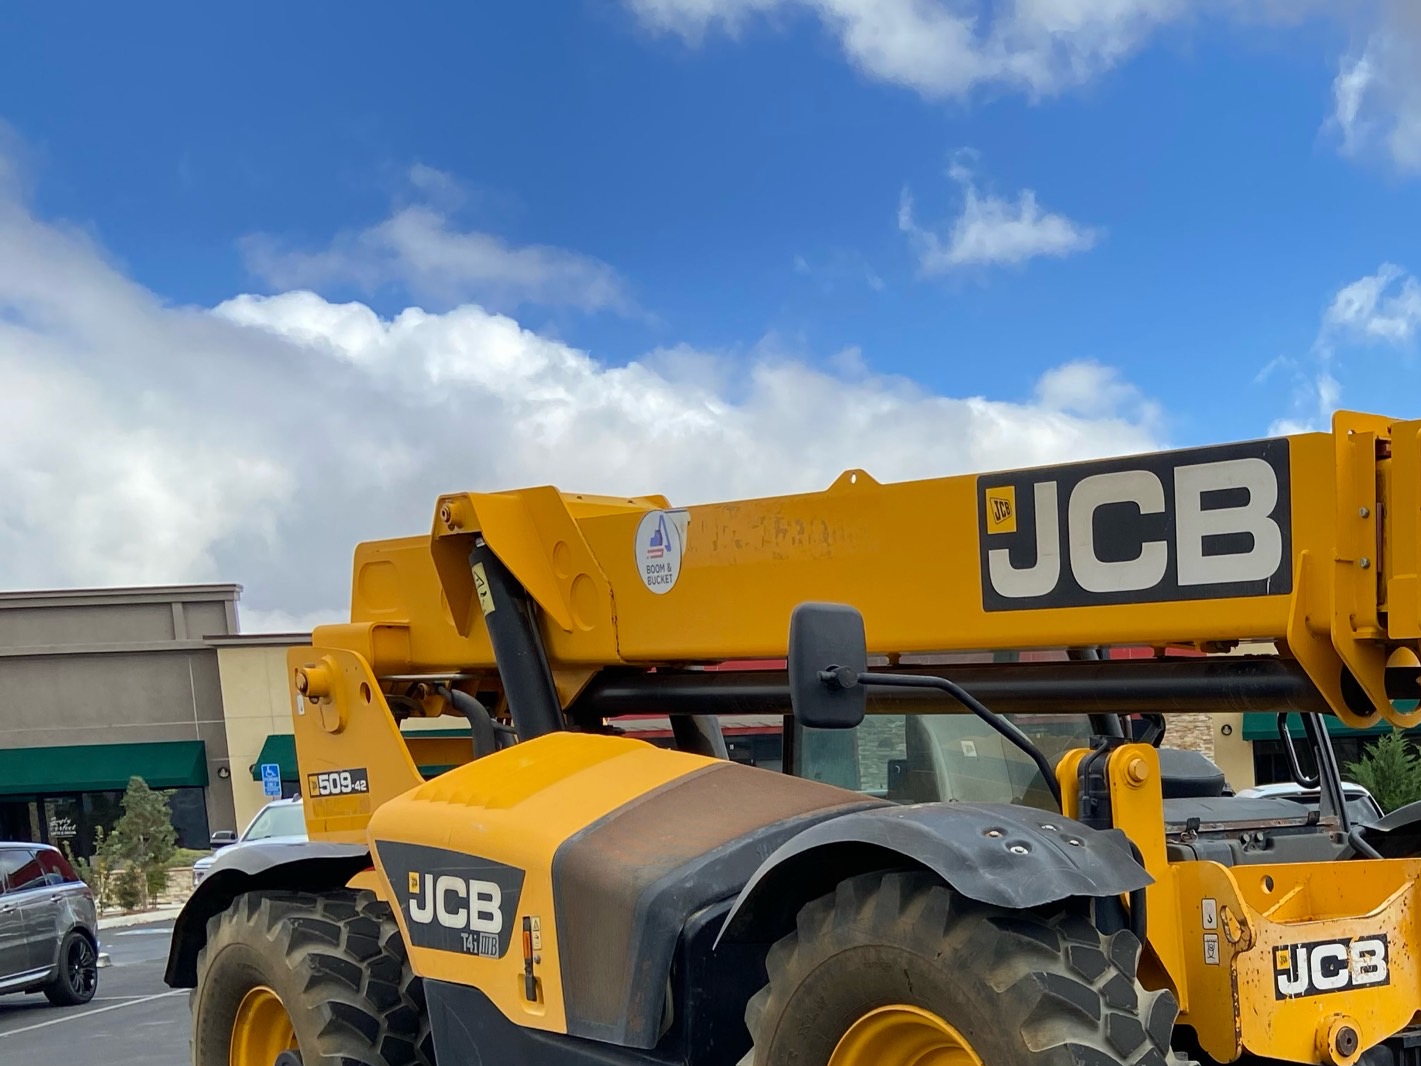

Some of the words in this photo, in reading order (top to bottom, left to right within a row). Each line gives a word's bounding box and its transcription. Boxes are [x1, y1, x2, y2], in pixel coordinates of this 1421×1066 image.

[993, 499, 1012, 522] JCB
[988, 457, 1282, 598] JCB
[646, 563, 666, 575] BOOM
[666, 562, 673, 573] &
[647, 573, 673, 586] BUCKET
[408, 872, 503, 934] JCB
[460, 932, 479, 954] T4i
[1276, 938, 1388, 996] JCB
